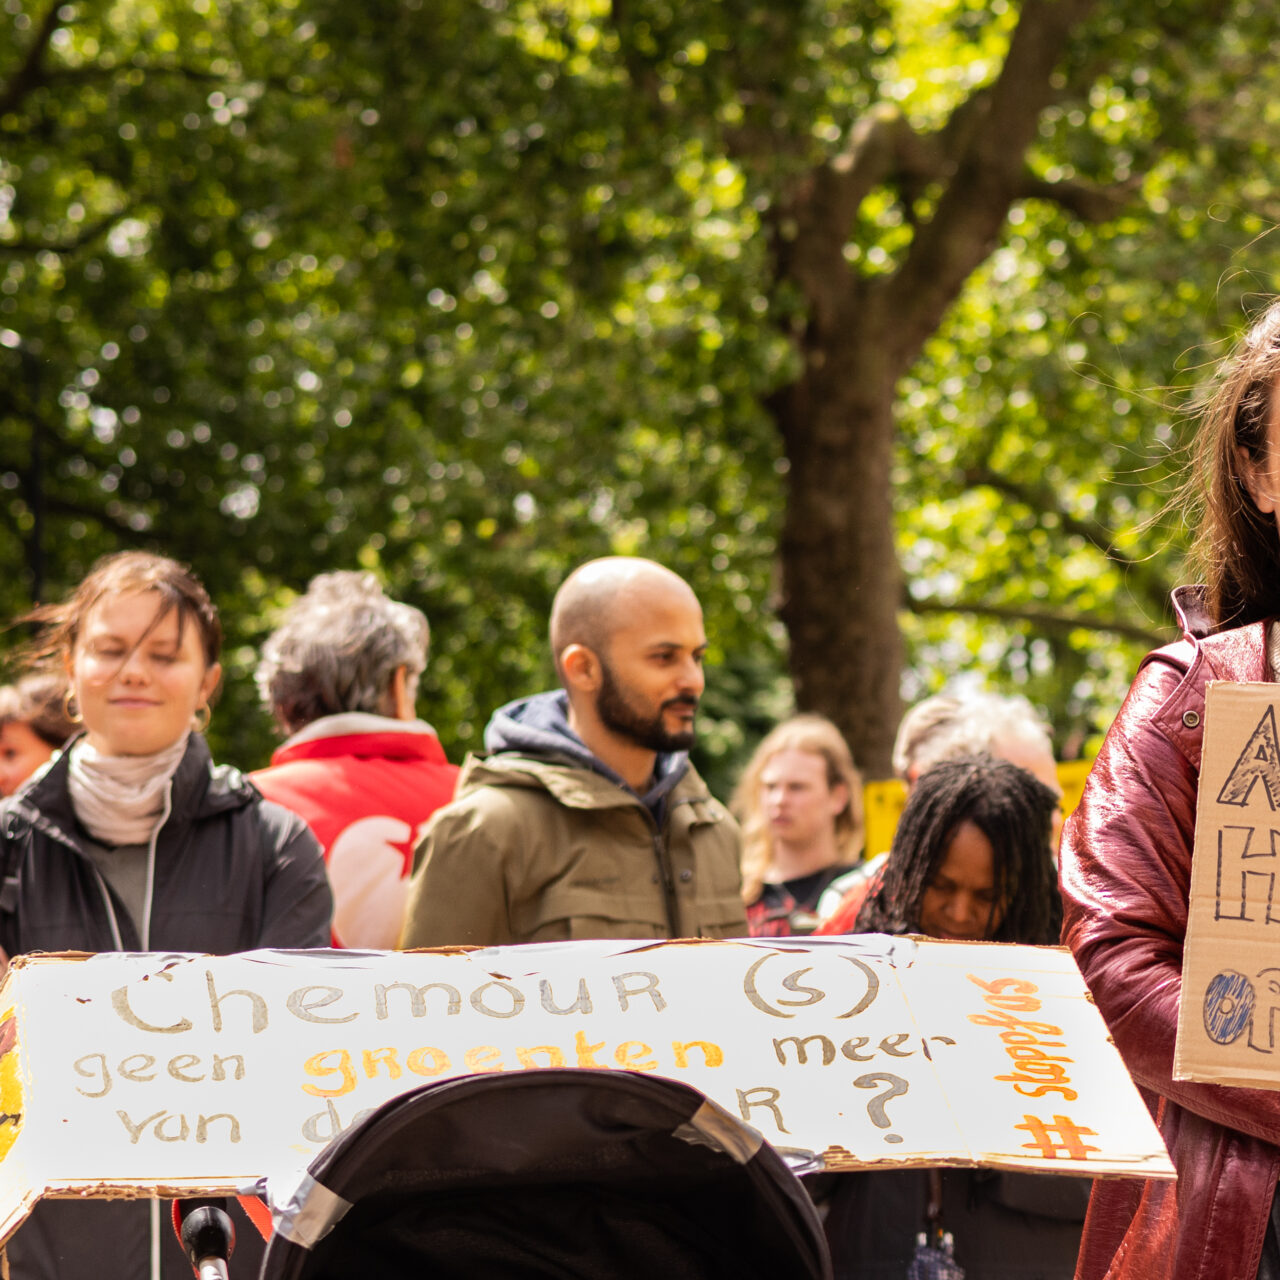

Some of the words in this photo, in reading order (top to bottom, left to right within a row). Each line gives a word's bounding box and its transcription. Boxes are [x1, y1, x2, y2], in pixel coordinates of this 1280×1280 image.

[73, 1050, 247, 1099] geen
[772, 1032, 958, 1067] meer
[116, 1107, 242, 1145] van
